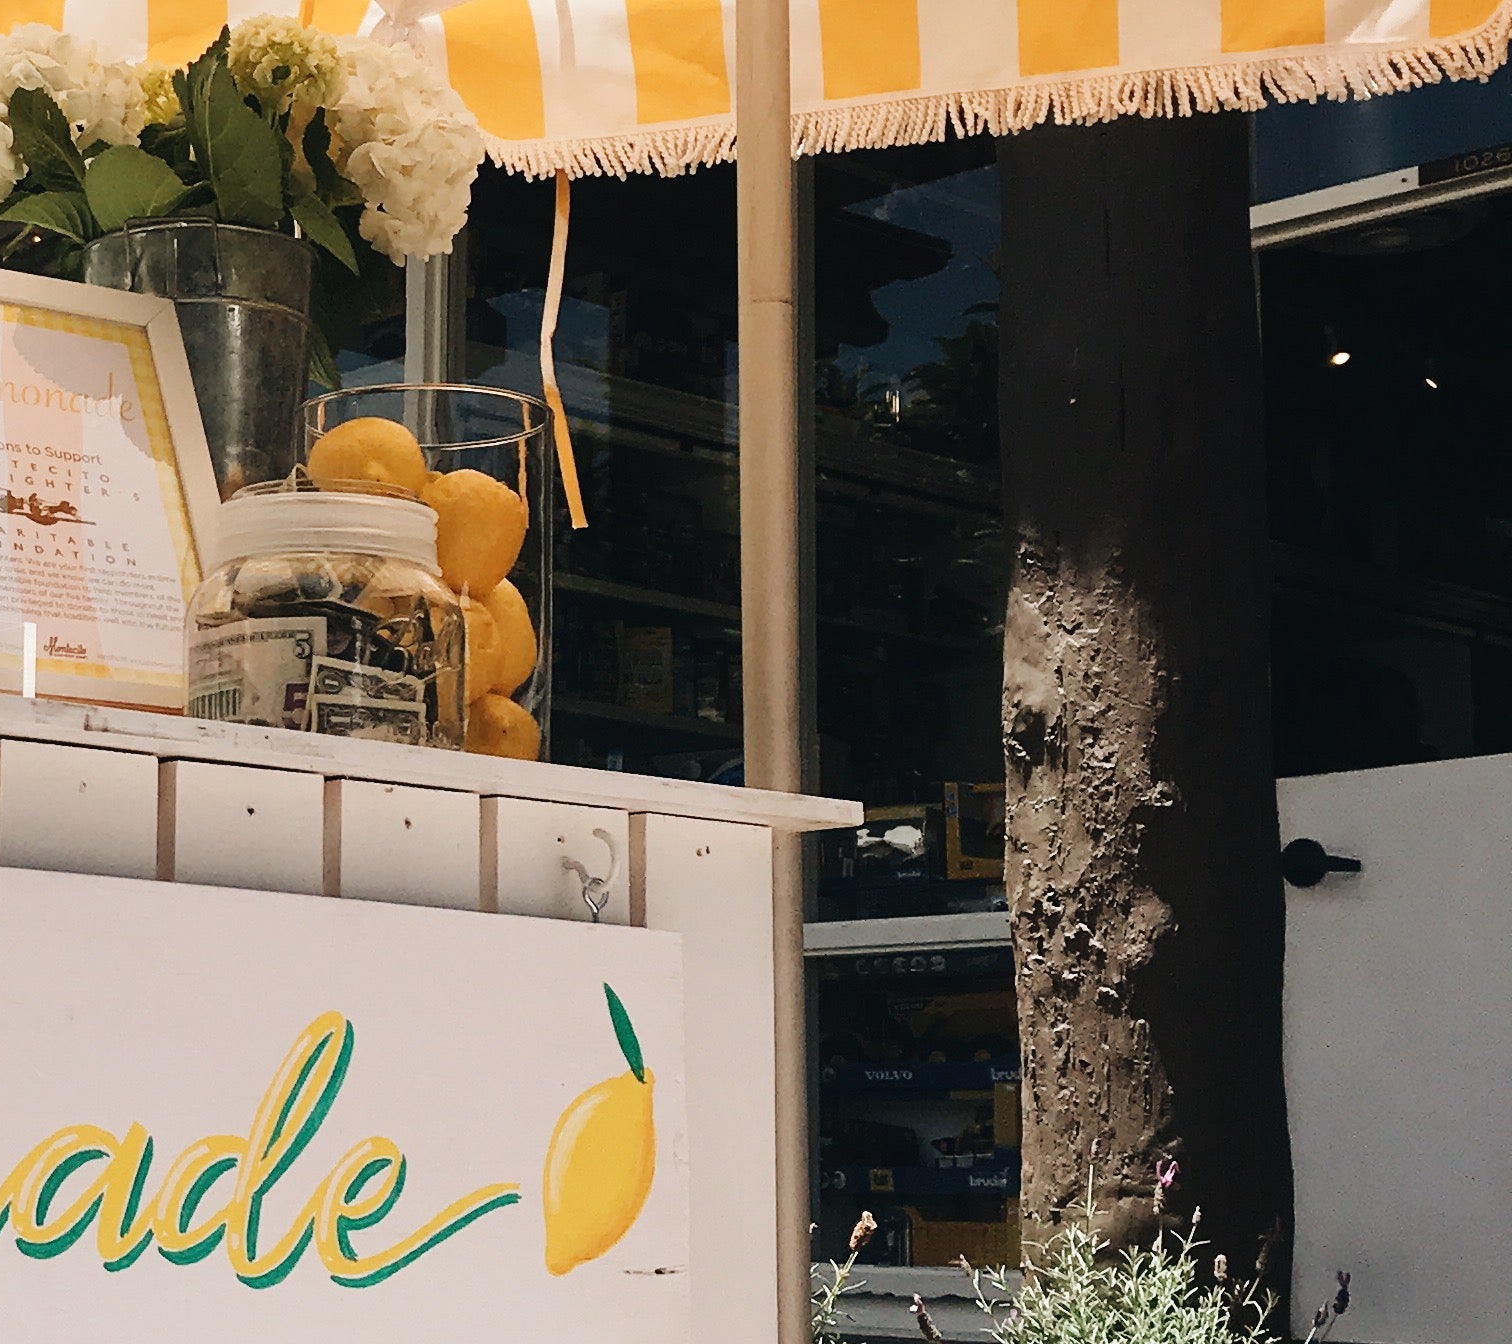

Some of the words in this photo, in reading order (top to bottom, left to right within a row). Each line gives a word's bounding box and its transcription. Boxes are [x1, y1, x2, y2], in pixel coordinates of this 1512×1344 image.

[25, 443, 41, 456] to
[44, 446, 103, 466] Support
[864, 1069, 913, 1081] VOLVO
